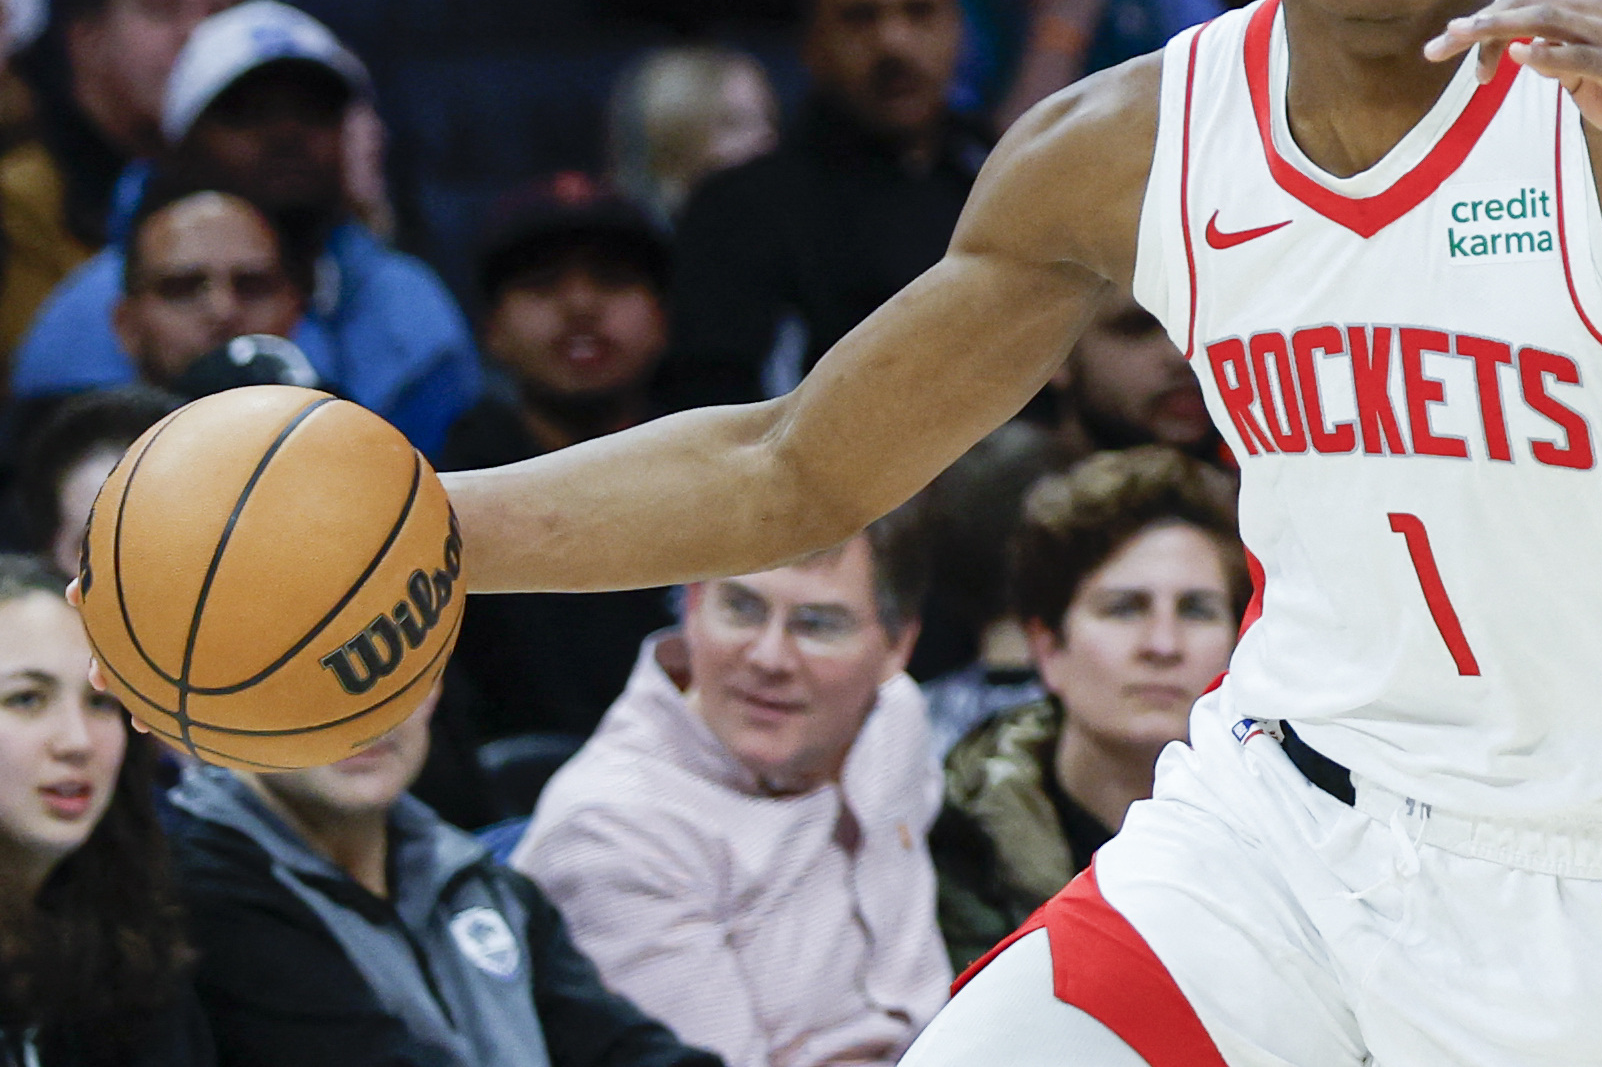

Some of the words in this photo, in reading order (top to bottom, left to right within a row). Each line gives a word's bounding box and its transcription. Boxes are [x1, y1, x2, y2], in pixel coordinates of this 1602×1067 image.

[1448, 228, 1553, 257] karma
[1451, 188, 1550, 223] credit
[1205, 322, 1597, 470] ROCKETS
[319, 499, 463, 695] Wilso
[1387, 512, 1481, 676] 1
